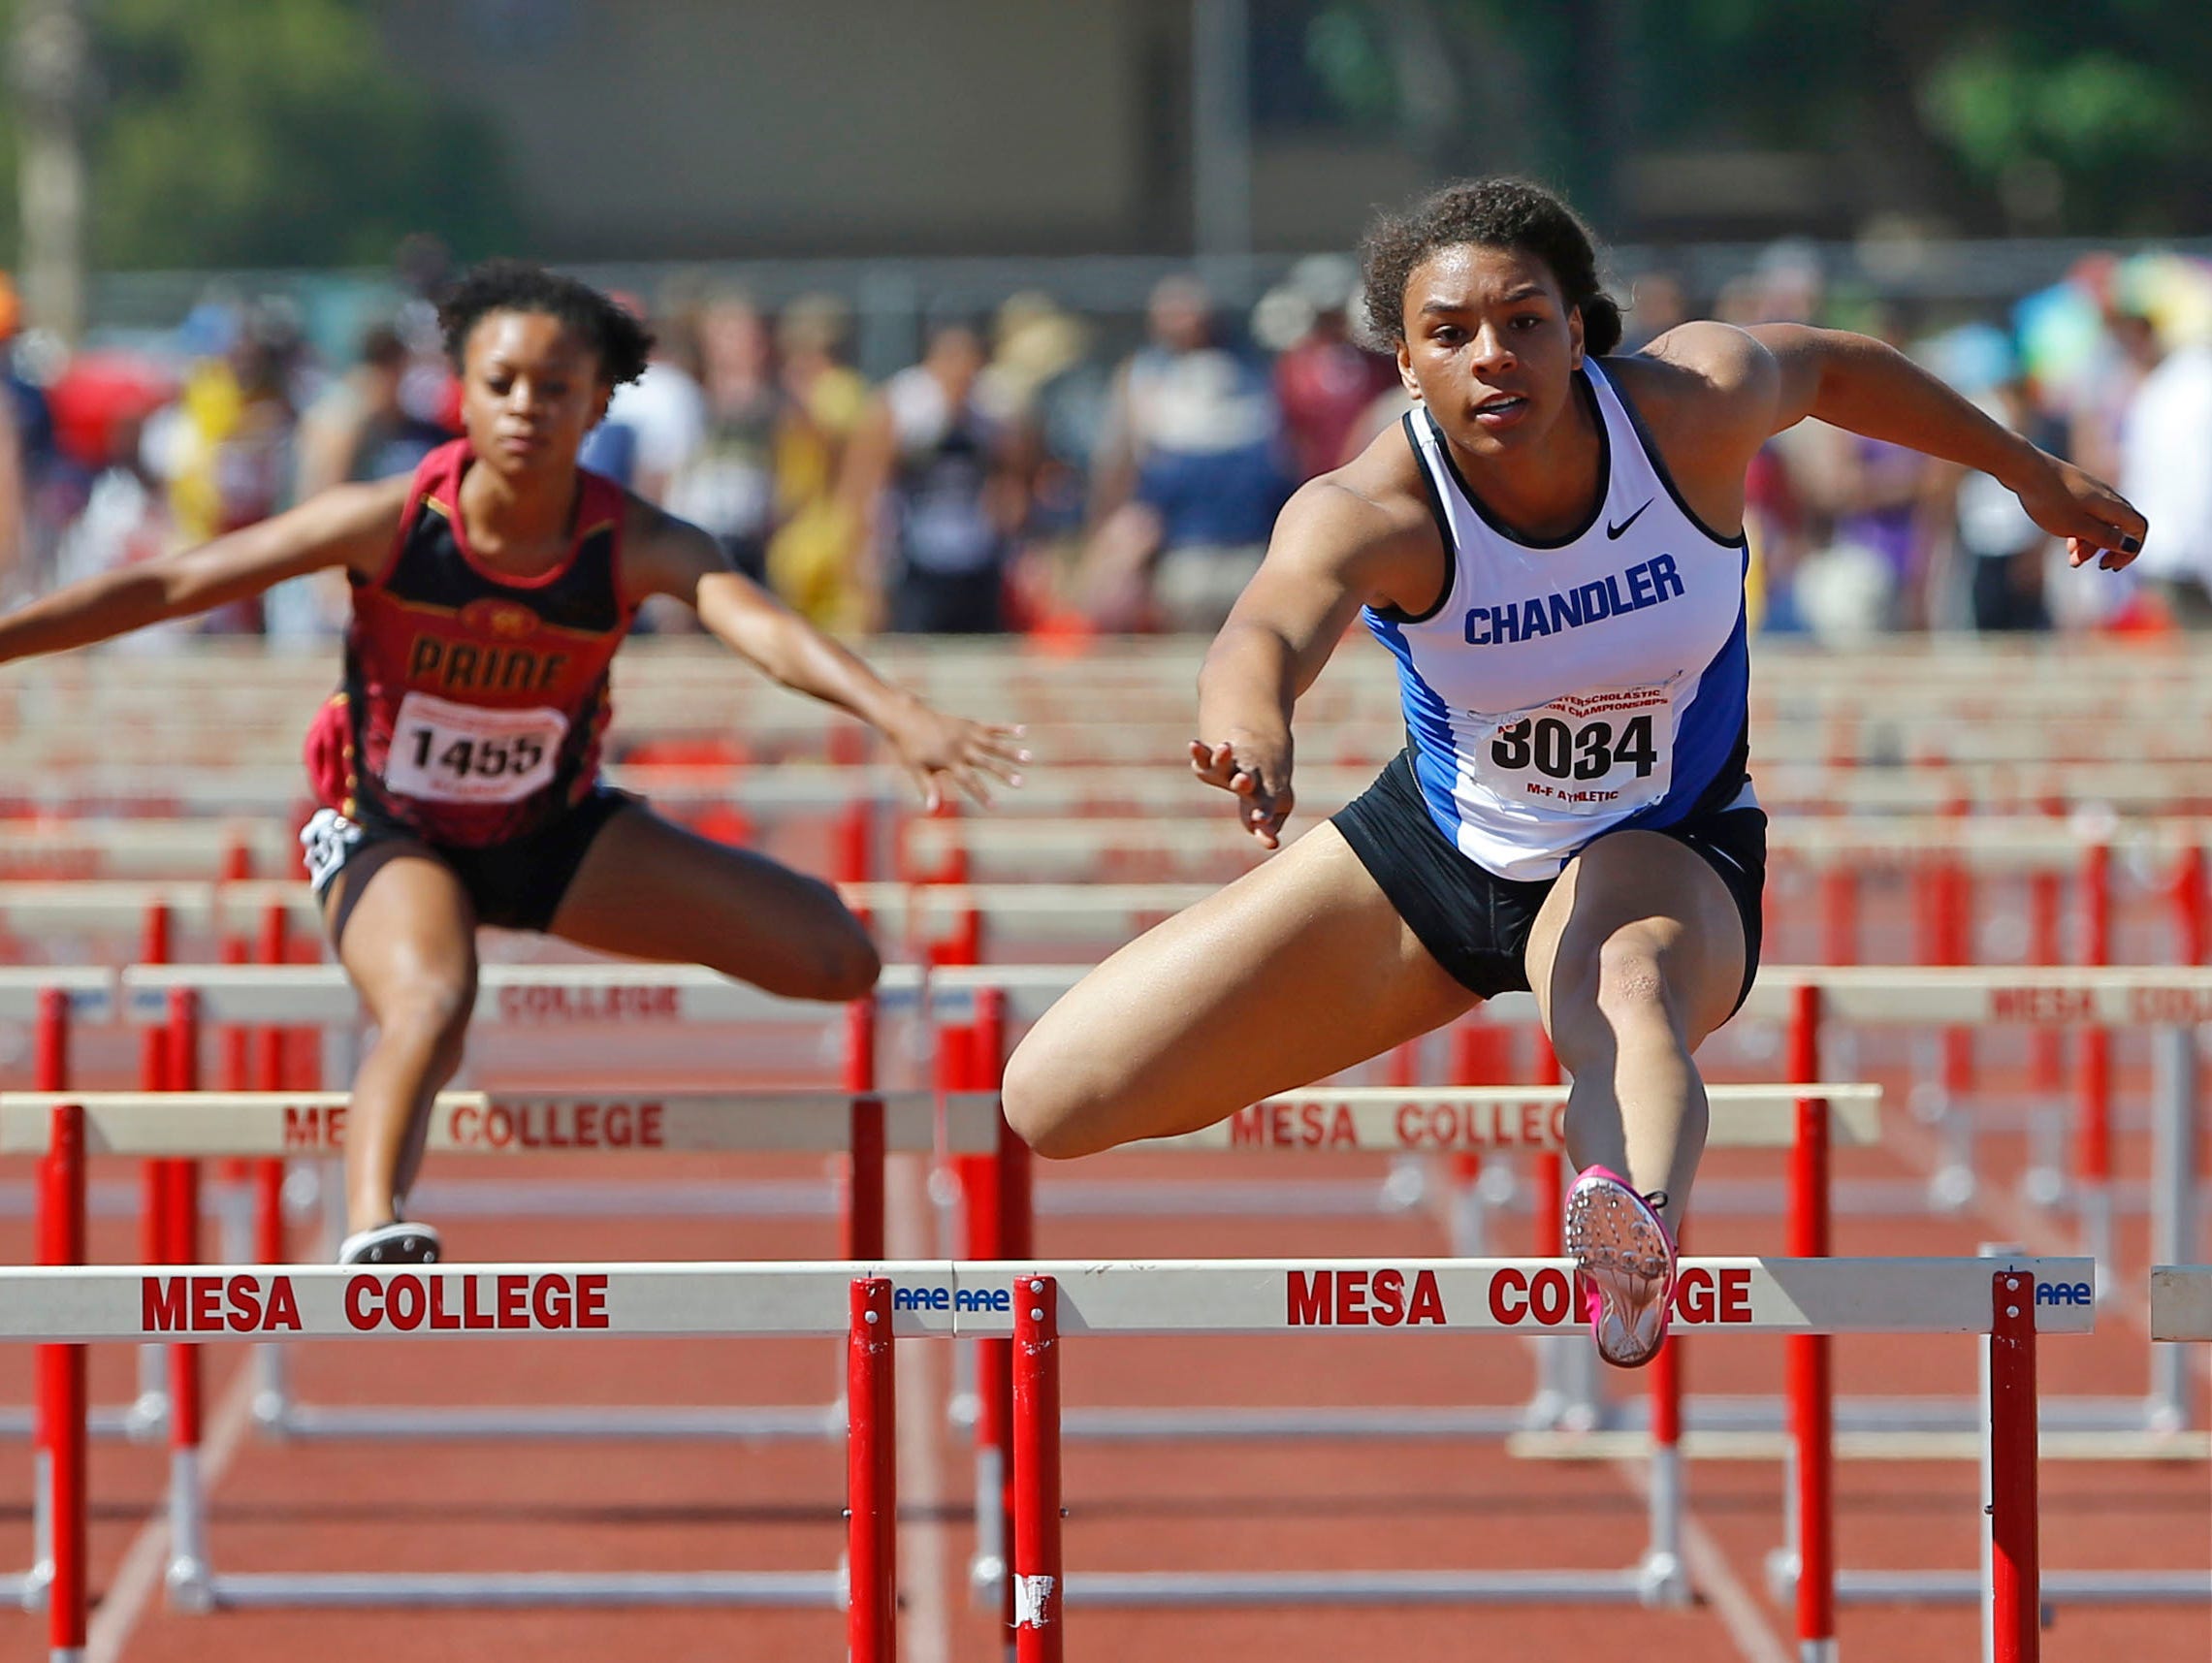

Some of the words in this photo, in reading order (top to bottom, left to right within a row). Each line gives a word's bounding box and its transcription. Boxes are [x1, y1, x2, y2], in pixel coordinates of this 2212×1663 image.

[1464, 553, 1685, 646] CHANDLER
[412, 728, 543, 778] 1455
[1491, 715, 1657, 781] 3034
[1526, 783, 1554, 797] M-F
[1556, 789, 1619, 804] ATHLETIC
[450, 1104, 663, 1148] COLLEGE
[1232, 1103, 1357, 1147] MESA
[142, 1275, 302, 1331] MESA
[344, 1273, 609, 1330] COLLEGE
[1287, 1269, 1447, 1327] MESA
[1488, 1267, 1752, 1326] COLGE
